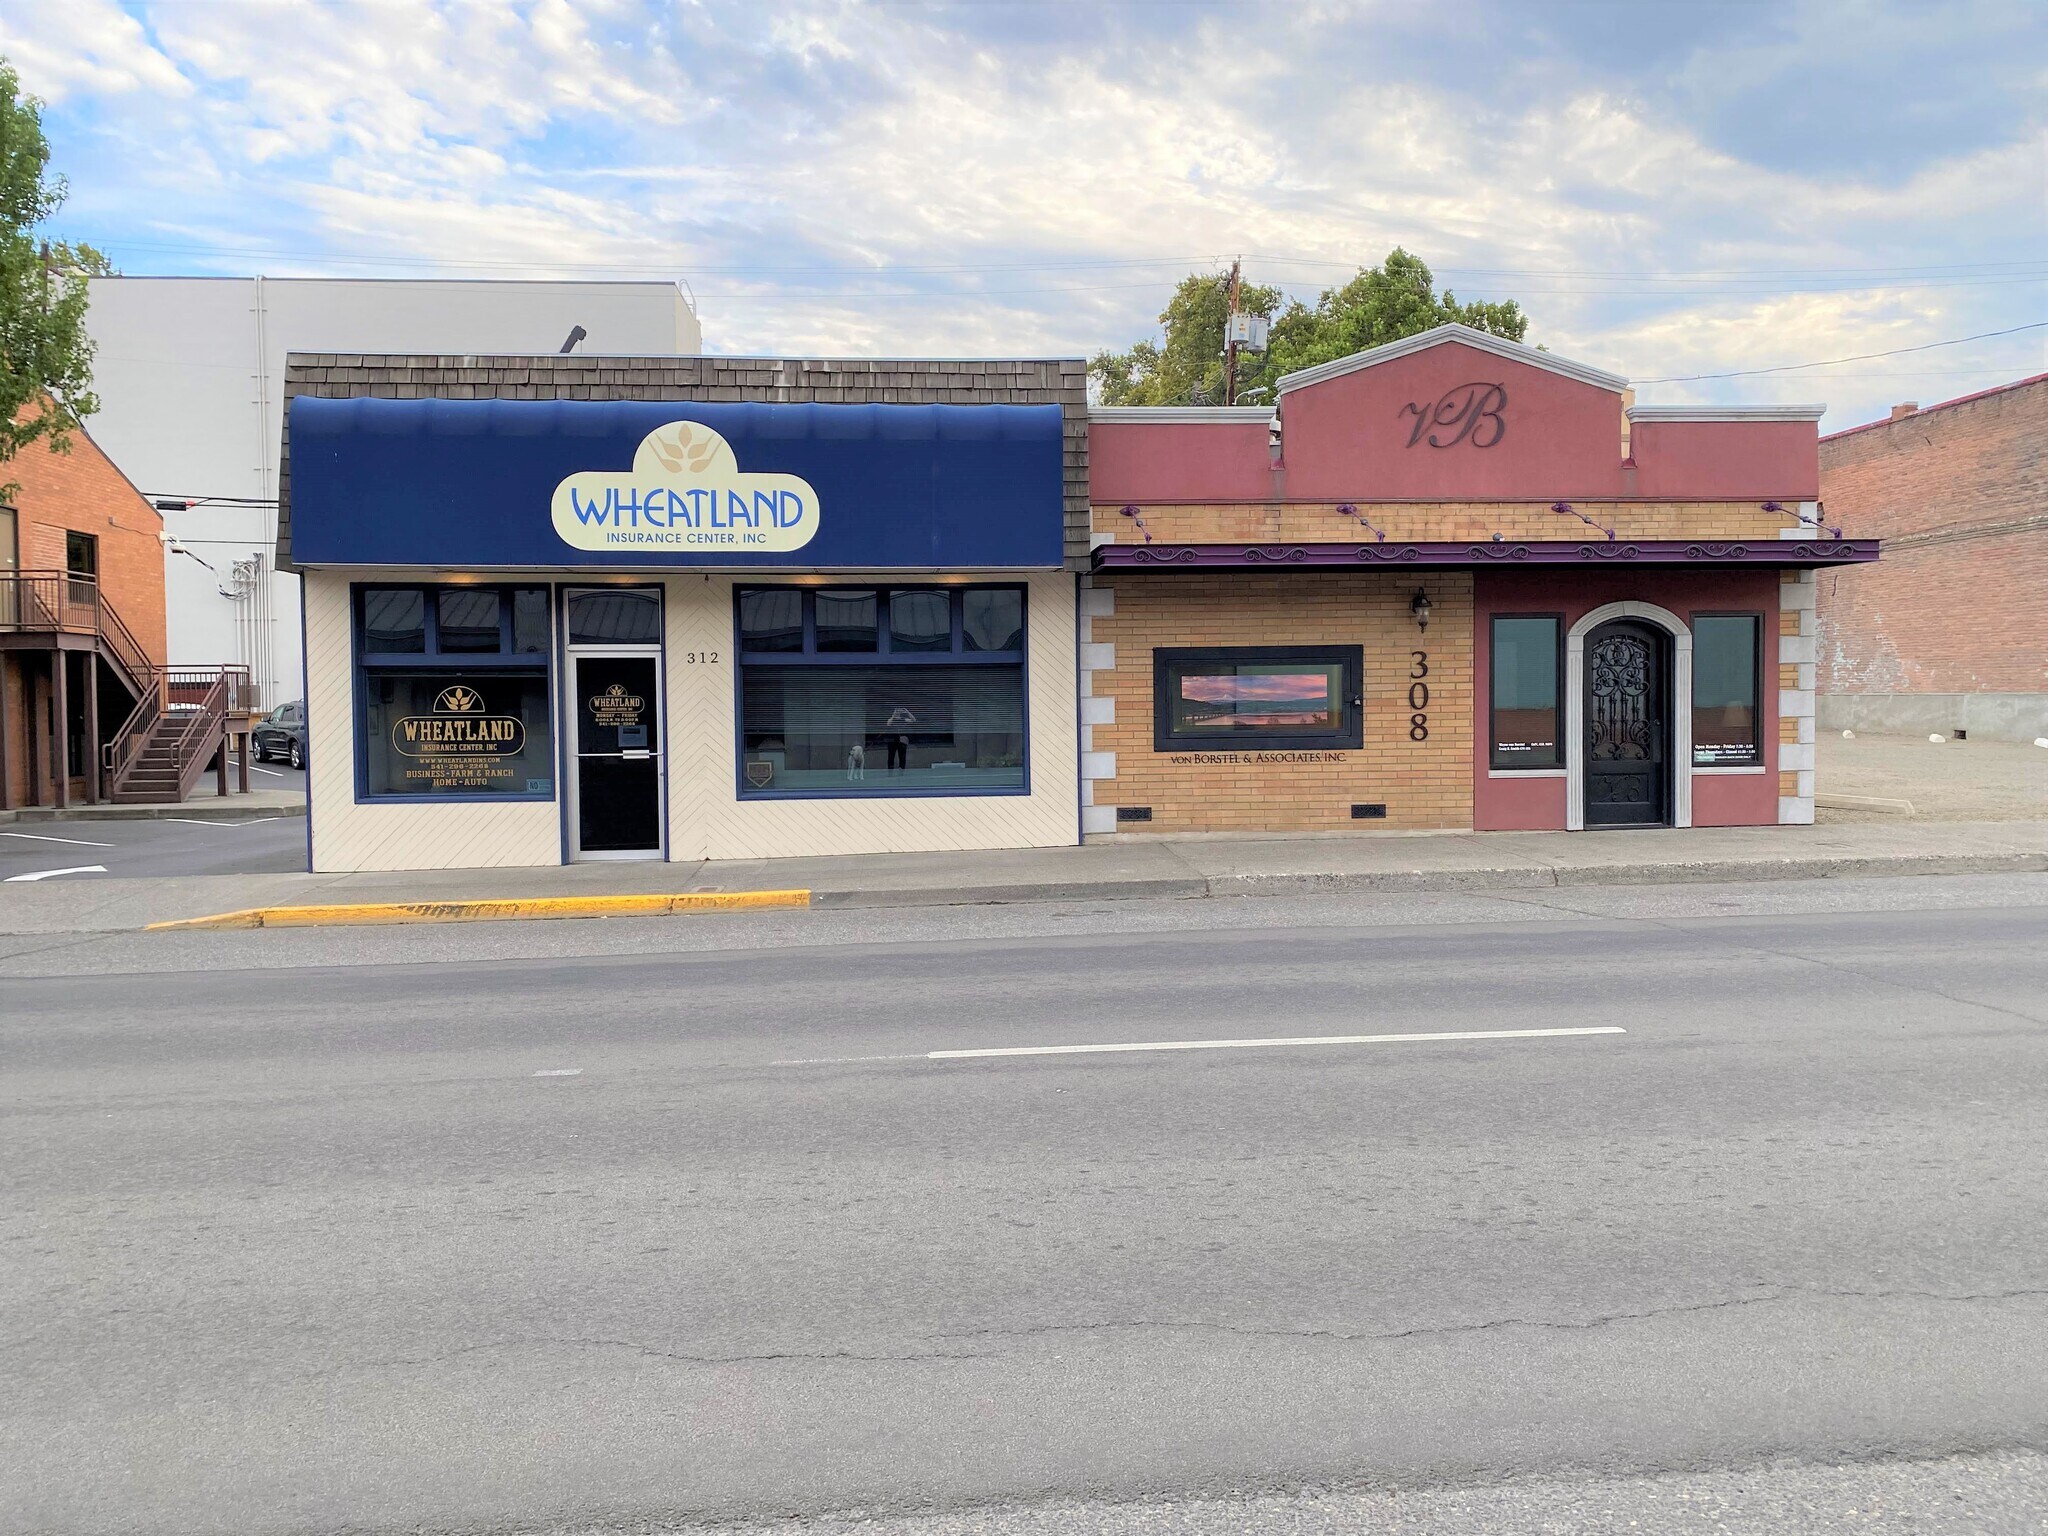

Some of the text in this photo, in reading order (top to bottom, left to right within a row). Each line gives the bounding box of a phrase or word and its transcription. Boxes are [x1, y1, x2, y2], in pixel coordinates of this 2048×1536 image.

[571, 487, 804, 528] WHEATLAND
[606, 532, 767, 545] INSURANCE CENTER, INC
[687, 652, 719, 664] 312
[593, 697, 641, 707] WHEATLAND
[1408, 650, 1430, 742] 308
[403, 720, 515, 741] WHEATLAND
[421, 743, 458, 752] INSURANCE
[486, 743, 498, 751] INC
[1194, 753, 1241, 764] BORSTEL
[1243, 753, 1252, 763] &
[485, 769, 514, 777] RANCH
